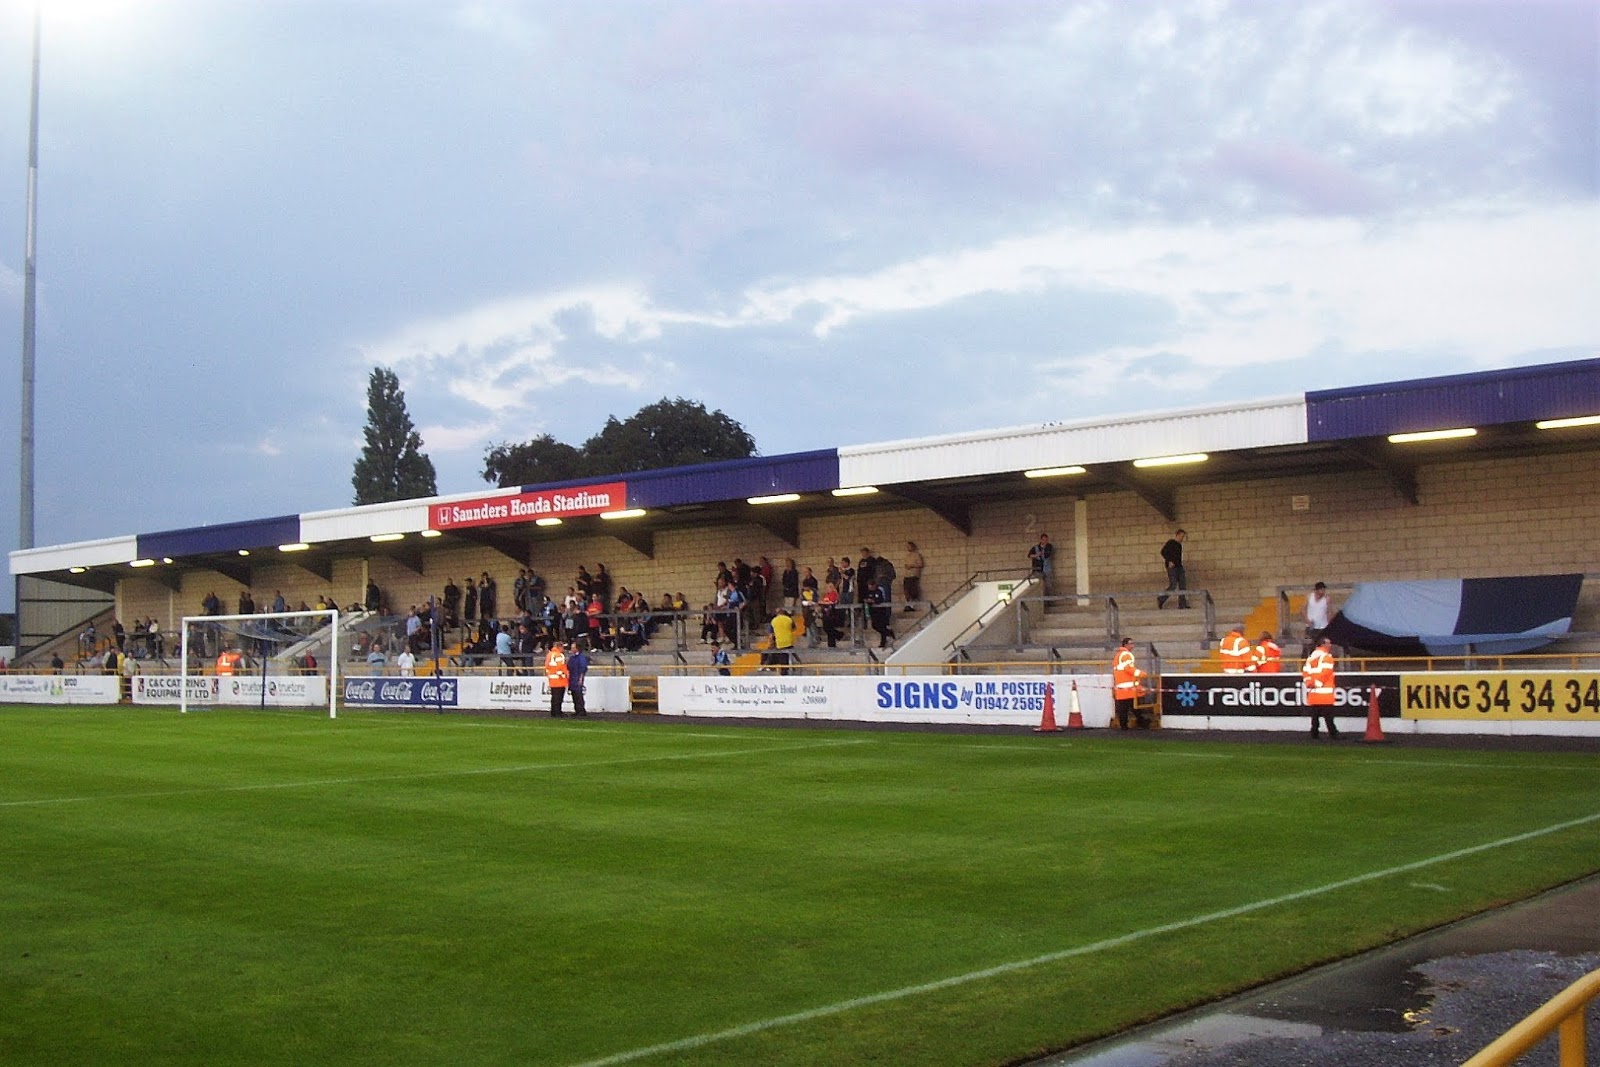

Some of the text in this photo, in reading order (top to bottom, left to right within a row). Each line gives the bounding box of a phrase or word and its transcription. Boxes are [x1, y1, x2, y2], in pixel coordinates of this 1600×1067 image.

[452, 491, 610, 522] Saunders Honda Stadium
[149, 678, 206, 688] C&C CATRING
[421, 681, 455, 701] CocaCola
[489, 681, 532, 698] Lafayette
[763, 684, 778, 694] Park
[780, 685, 798, 694] Hotel
[975, 682, 1055, 695] D.M. POSTERS
[195, 690, 209, 698] LTD
[876, 682, 973, 710] SIGNS by
[1208, 681, 1311, 706] radiocit
[1406, 679, 1600, 713] KING 34 34 34
[975, 697, 1055, 711] 01942 2585
